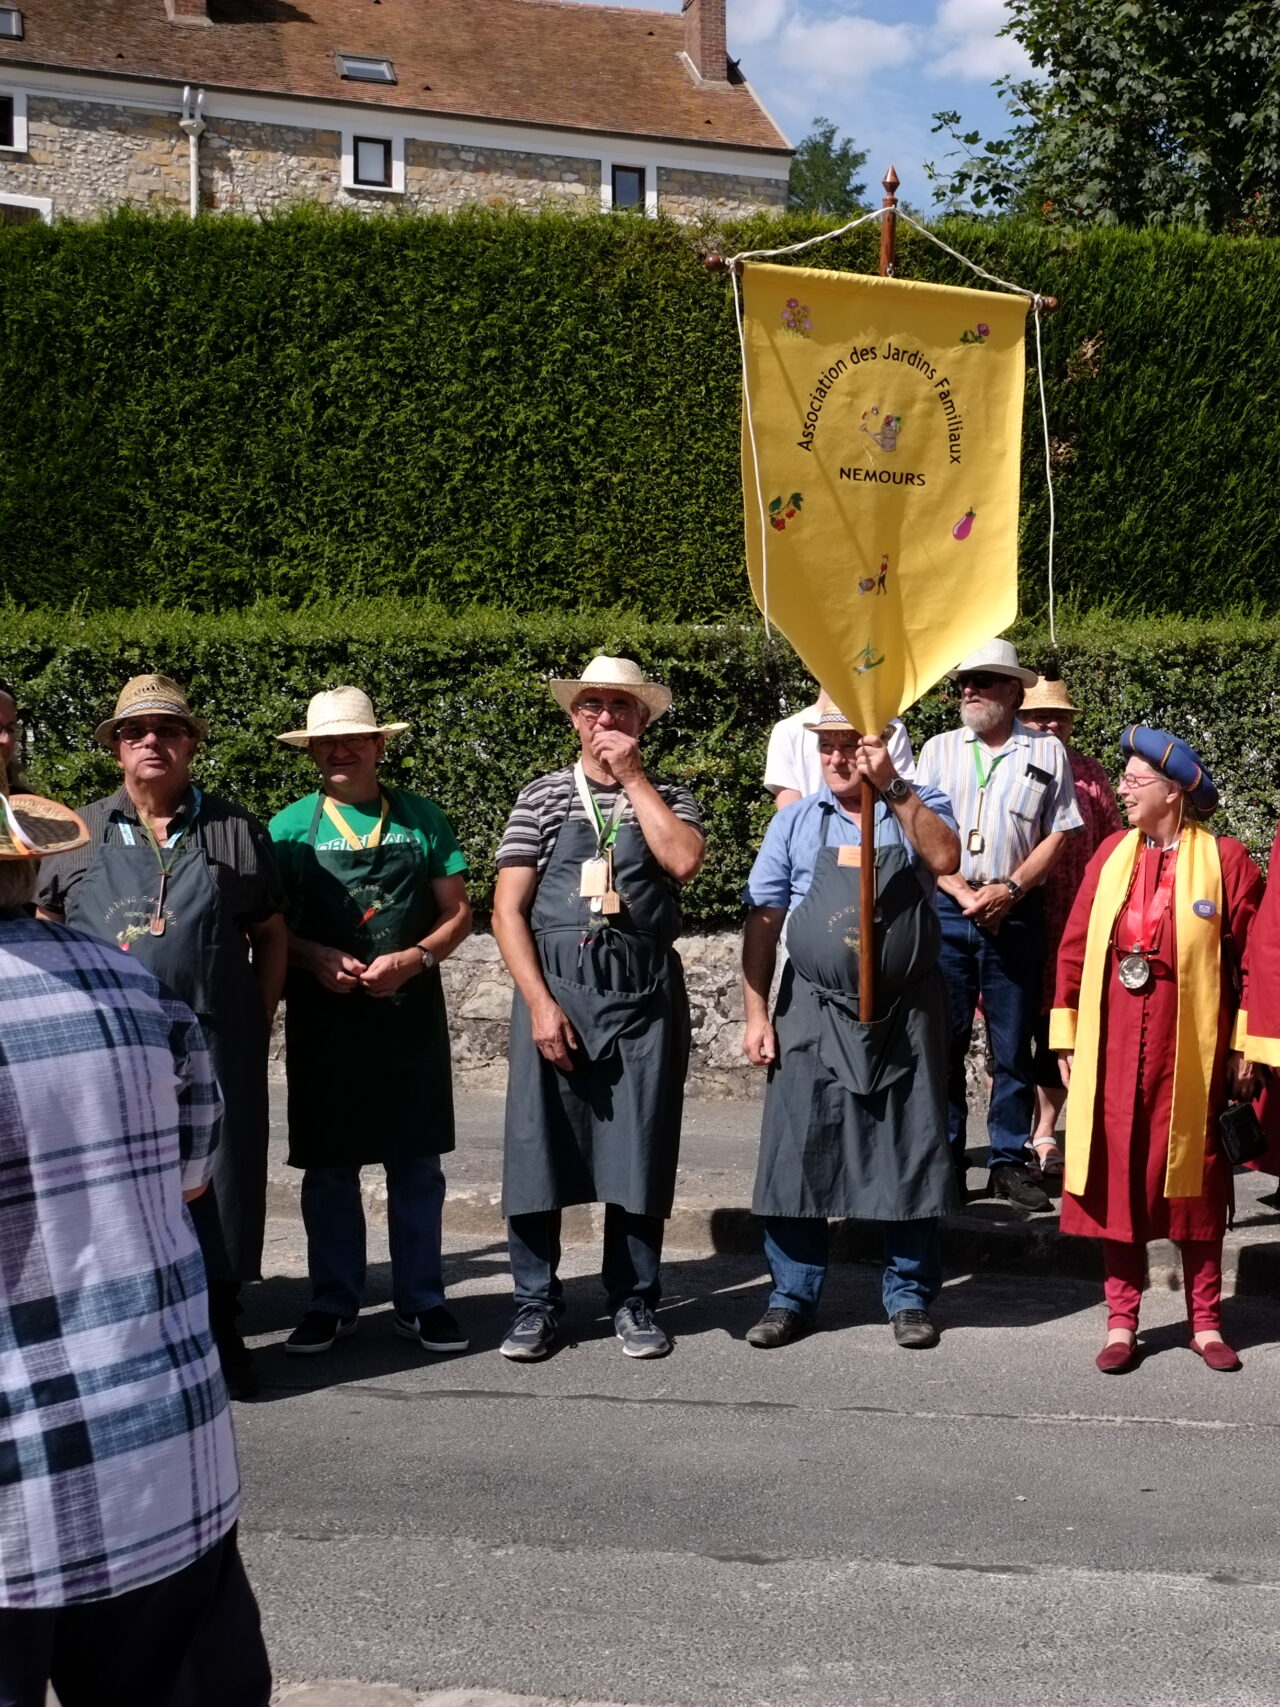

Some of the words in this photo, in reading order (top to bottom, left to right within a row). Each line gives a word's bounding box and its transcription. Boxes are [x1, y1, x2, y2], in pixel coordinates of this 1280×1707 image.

[796, 359, 848, 452] Association
[849, 346, 878, 365] des
[882, 342, 937, 380] Jardins
[934, 377, 964, 465] Familiaux
[839, 466, 926, 486] NEMOURS
